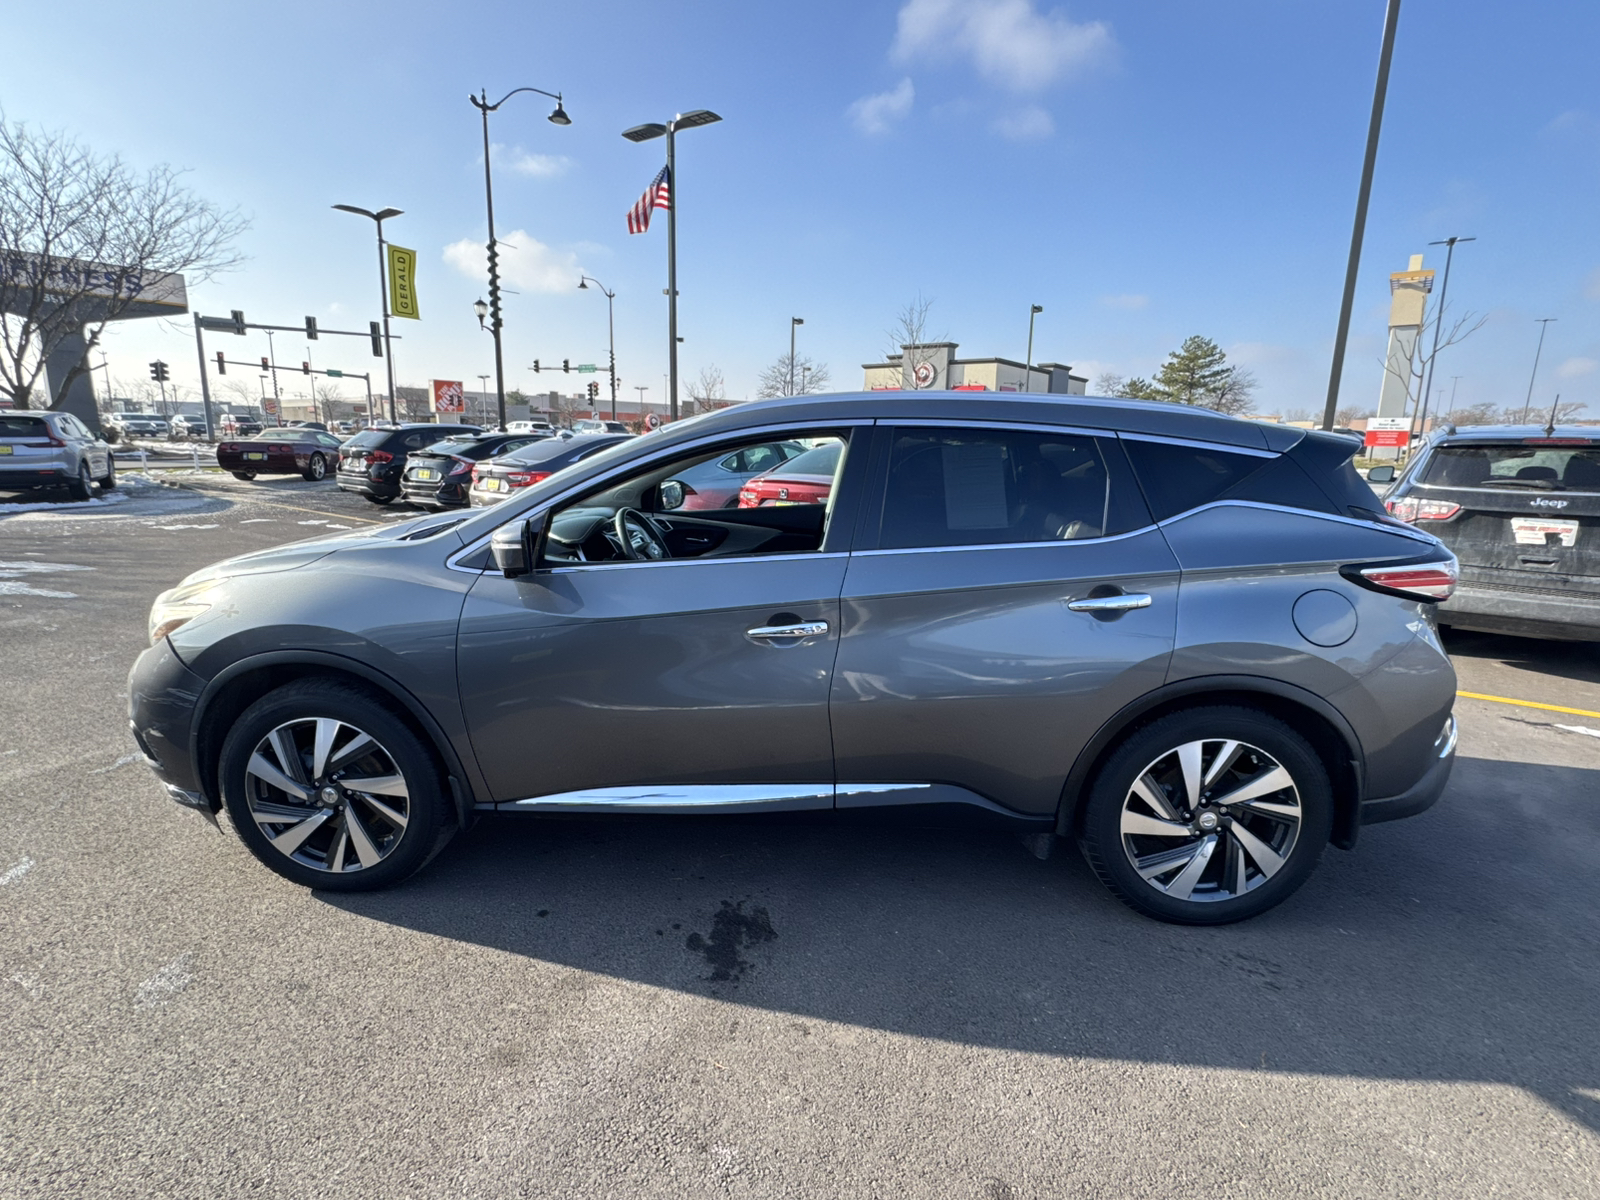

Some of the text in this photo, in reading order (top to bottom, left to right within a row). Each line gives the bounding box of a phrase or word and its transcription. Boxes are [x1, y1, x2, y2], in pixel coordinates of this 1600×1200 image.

[396, 256, 409, 310] GERALD
[436, 382, 463, 412] HOME
[437, 384, 450, 397] THE
[1530, 497, 1568, 509] Jeep
